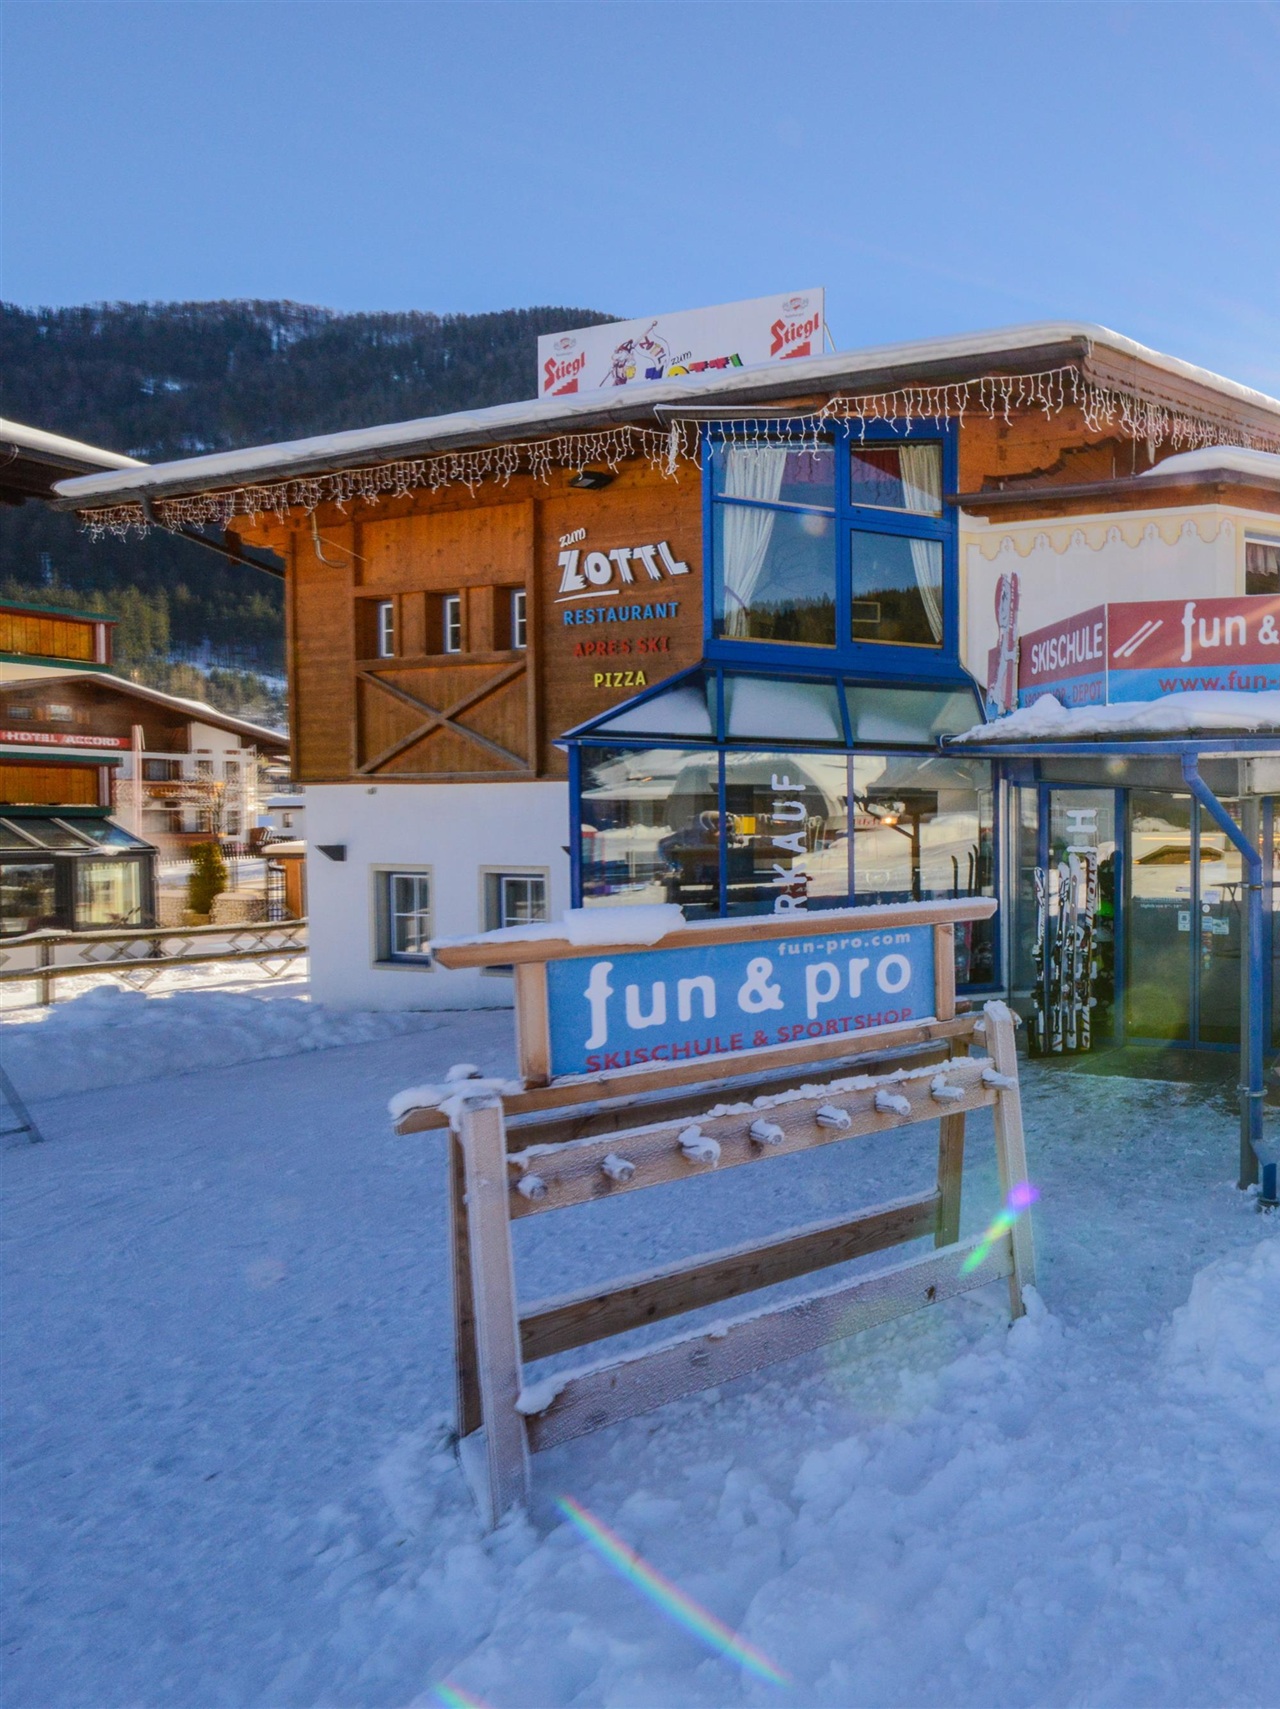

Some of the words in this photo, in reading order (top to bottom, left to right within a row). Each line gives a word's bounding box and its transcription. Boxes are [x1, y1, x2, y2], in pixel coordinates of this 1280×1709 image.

[770, 311, 820, 357] Stiegl
[543, 351, 586, 392] Stiegl
[557, 540, 690, 593] ZOTTL
[563, 601, 680, 625] RESTAURANT
[1180, 601, 1248, 663] fun
[1257, 614, 1280, 645] &
[636, 636, 671, 654] SKI
[1030, 621, 1104, 675] SKISCHULE
[594, 670, 647, 688] PIZZA
[1072, 680, 1103, 704] DEPOT
[6, 731, 58, 744] HOTEL
[63, 734, 121, 747] ACCORD
[778, 932, 911, 956] fun-pro.com
[583, 960, 717, 1051] fun
[736, 956, 785, 1014] &
[804, 953, 912, 1021] pro
[585, 1032, 744, 1074] SKISCHULE
[752, 1029, 769, 1047] &
[777, 1007, 913, 1043] SPORTSHOP
